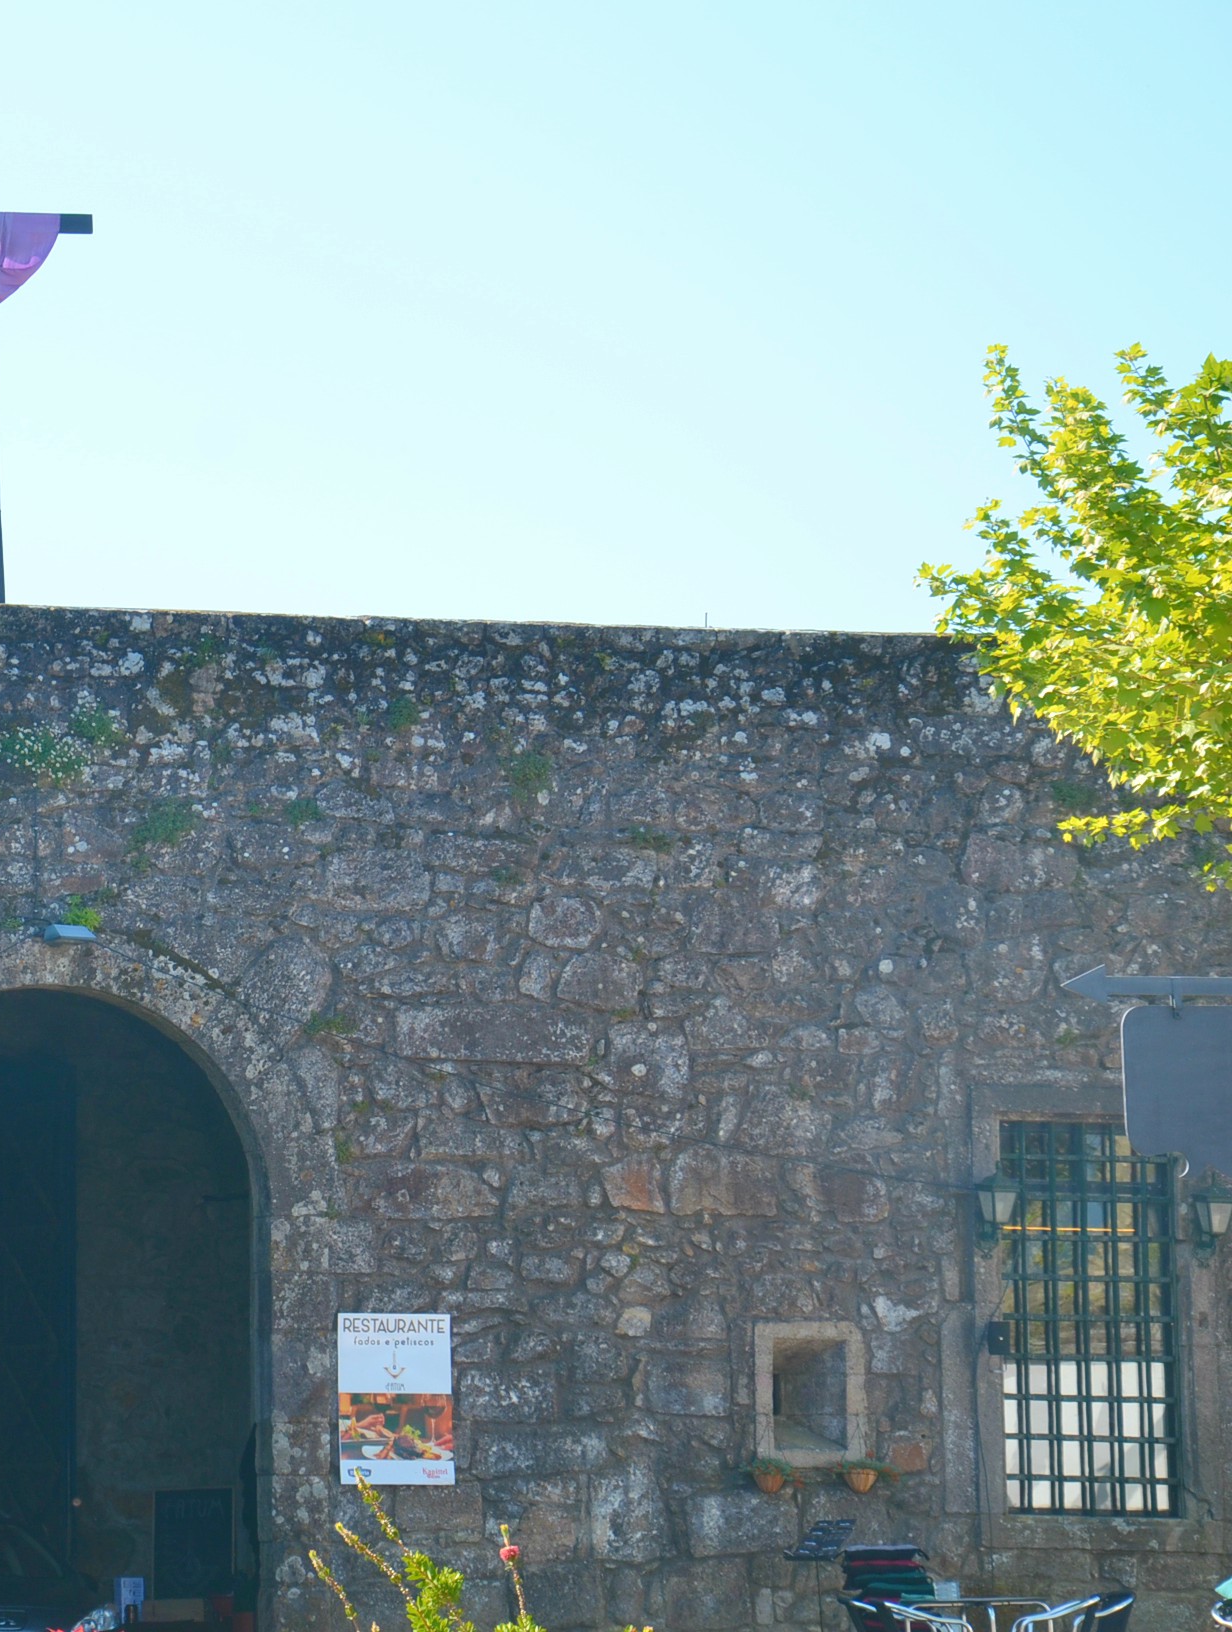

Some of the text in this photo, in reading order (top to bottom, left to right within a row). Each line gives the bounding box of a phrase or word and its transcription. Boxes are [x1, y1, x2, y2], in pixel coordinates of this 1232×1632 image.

[343, 1318, 445, 1333] RESTAURANTE
[354, 1336, 380, 1346] fados
[394, 1337, 434, 1348] petiscos
